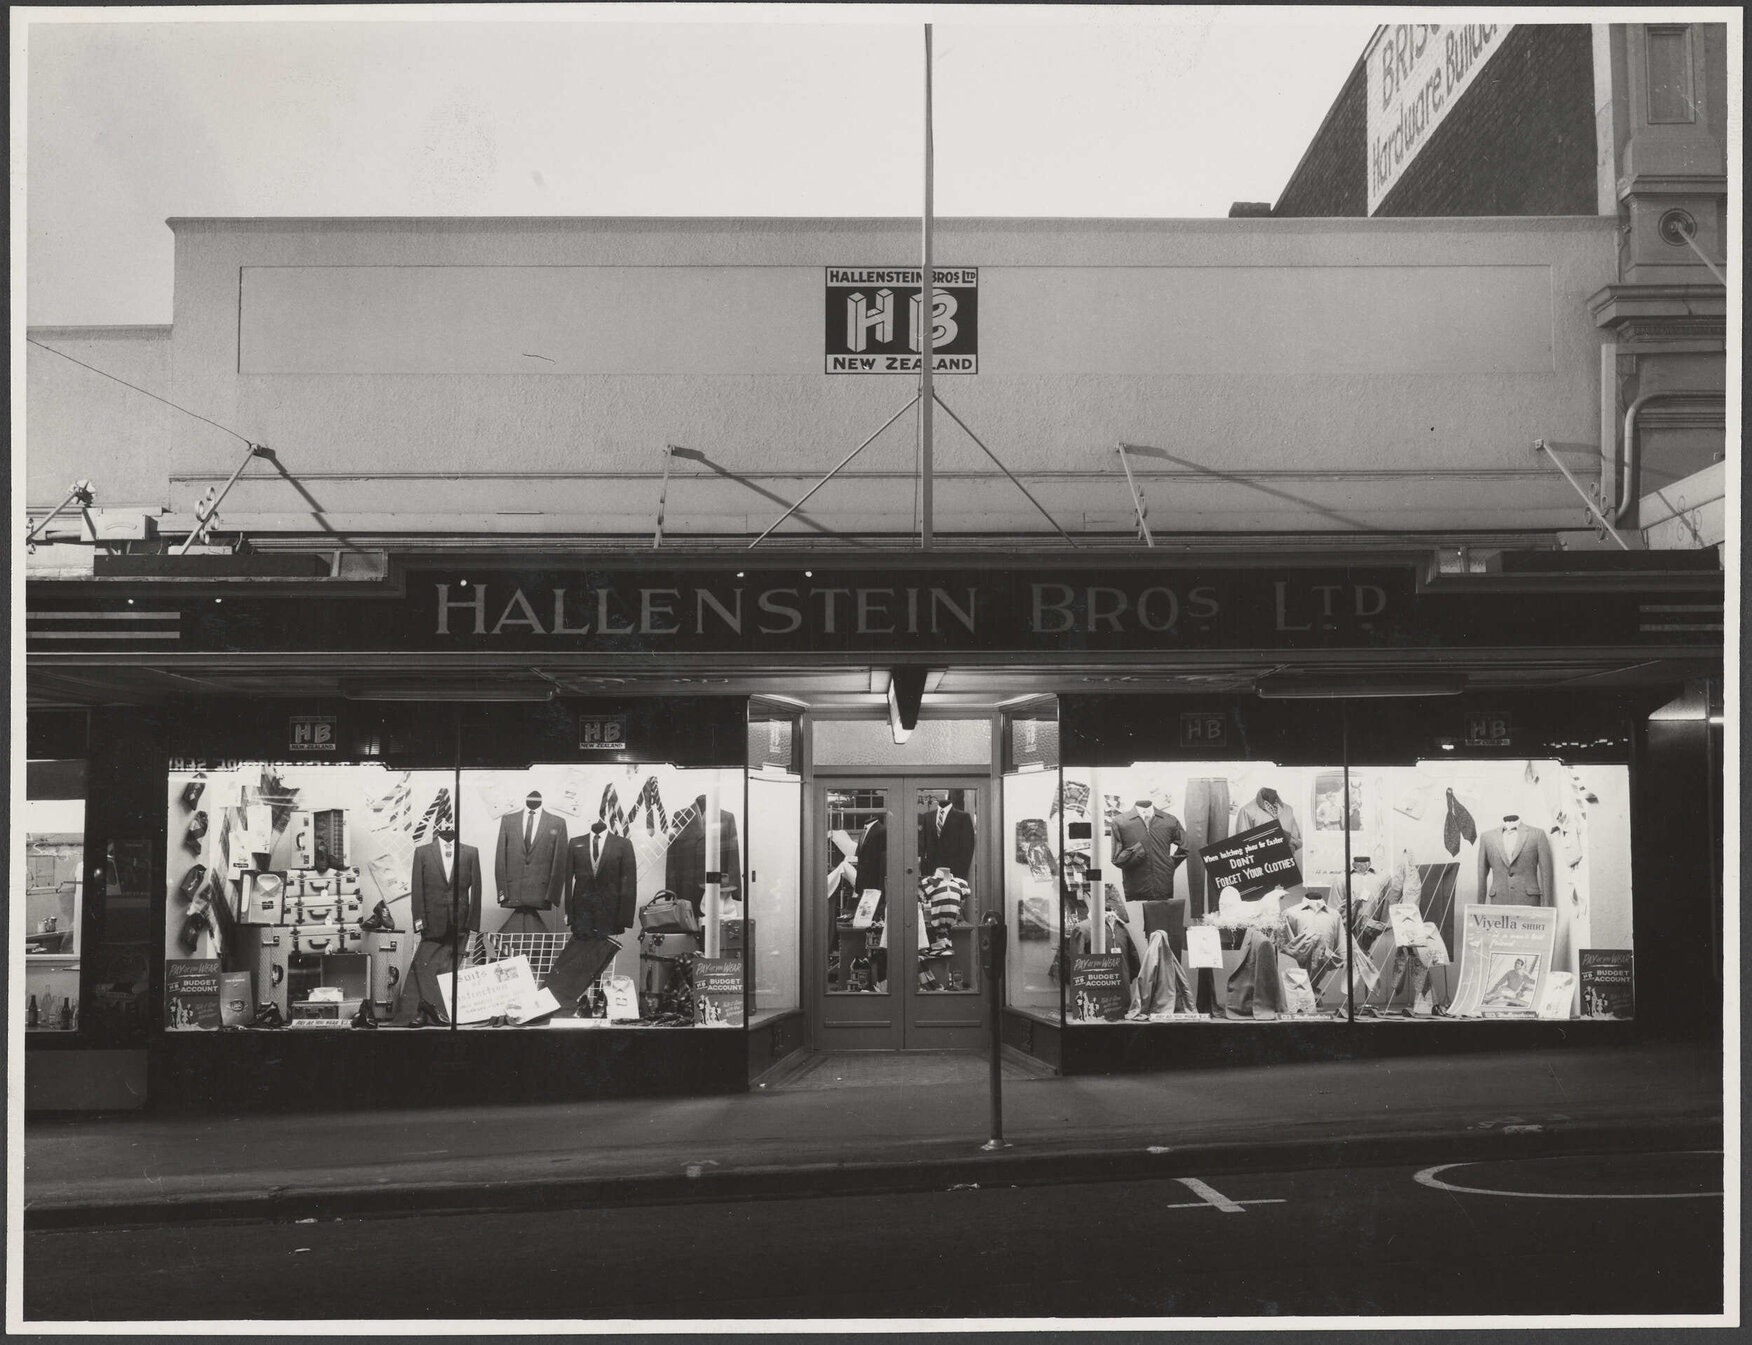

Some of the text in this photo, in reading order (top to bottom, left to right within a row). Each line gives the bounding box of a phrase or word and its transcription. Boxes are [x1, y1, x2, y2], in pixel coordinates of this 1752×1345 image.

[829, 269, 922, 284] HALLENSTEIN
[833, 357, 972, 370] NEW ZEAAND
[435, 582, 977, 635] HALLENSTEIN
[1203, 854, 1219, 864] When
[1219, 847, 1243, 859] hatching
[1244, 843, 1258, 853] plans
[1266, 836, 1284, 847] Easter
[1215, 857, 1296, 889] FORGET YOUR CLOTHES
[1521, 923, 1546, 931] SHIRT
[168, 963, 185, 975] PAY
[696, 962, 711, 976] PAY
[1074, 959, 1090, 971] PAY
